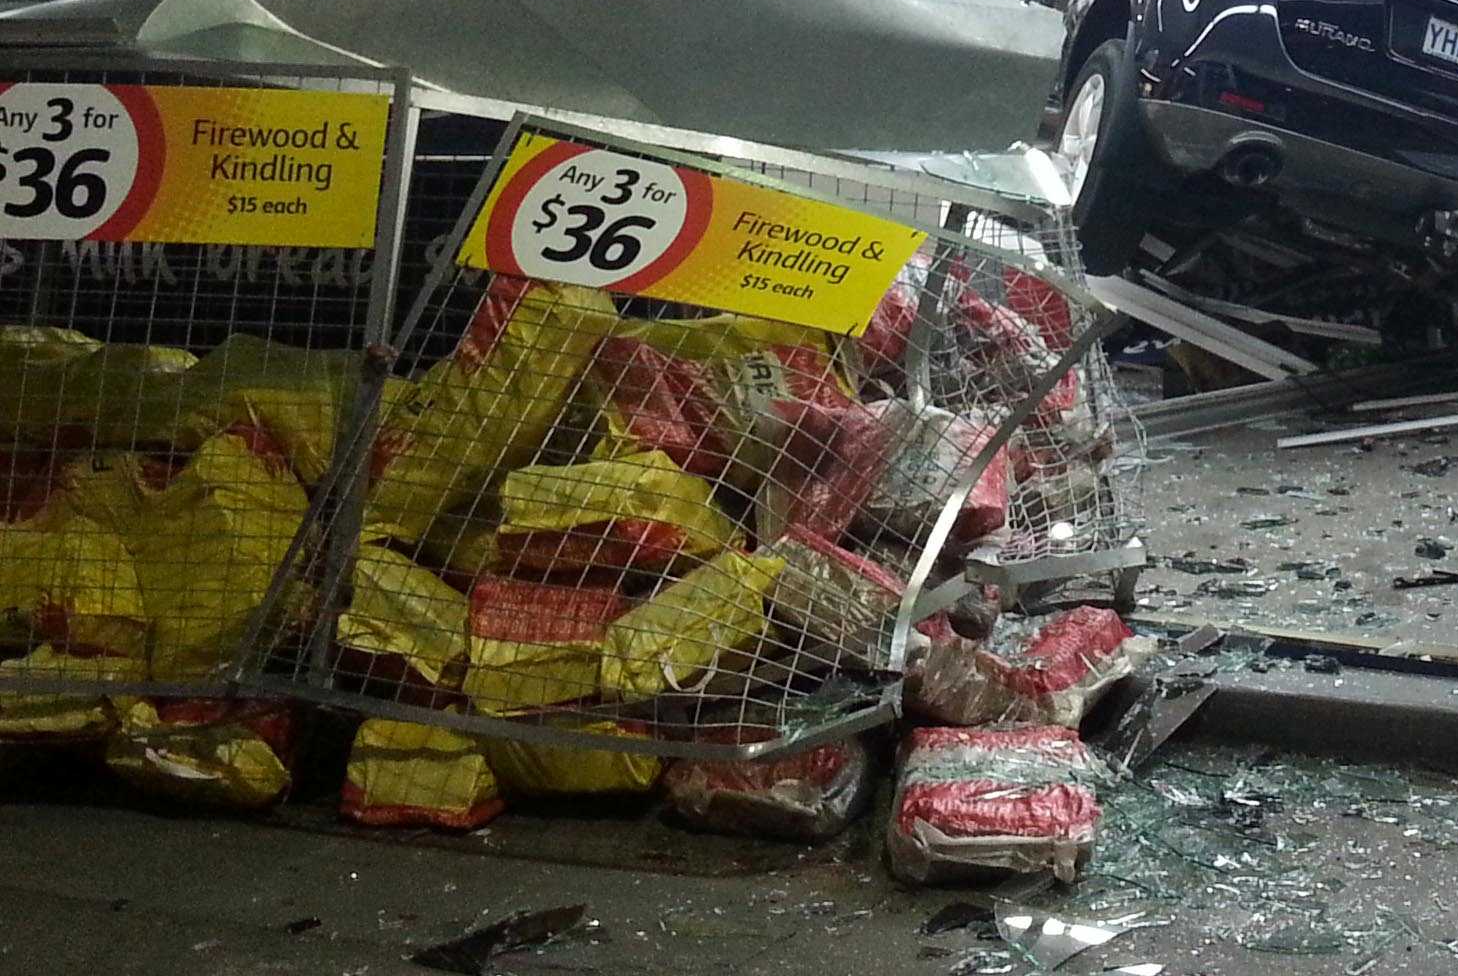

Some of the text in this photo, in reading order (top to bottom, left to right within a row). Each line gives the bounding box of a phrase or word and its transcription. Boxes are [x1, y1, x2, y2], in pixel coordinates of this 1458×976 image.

[42, 97, 74, 142] 3
[82, 106, 119, 129] for
[191, 119, 360, 151] Firewood &
[210, 154, 333, 191] Kindling
[558, 164, 677, 205] Any 3 for
[227, 195, 308, 215] $15 each
[532, 193, 656, 271] $36
[733, 211, 885, 262] Firewood &
[737, 240, 850, 285] Kindling
[740, 272, 814, 301] $15 each
